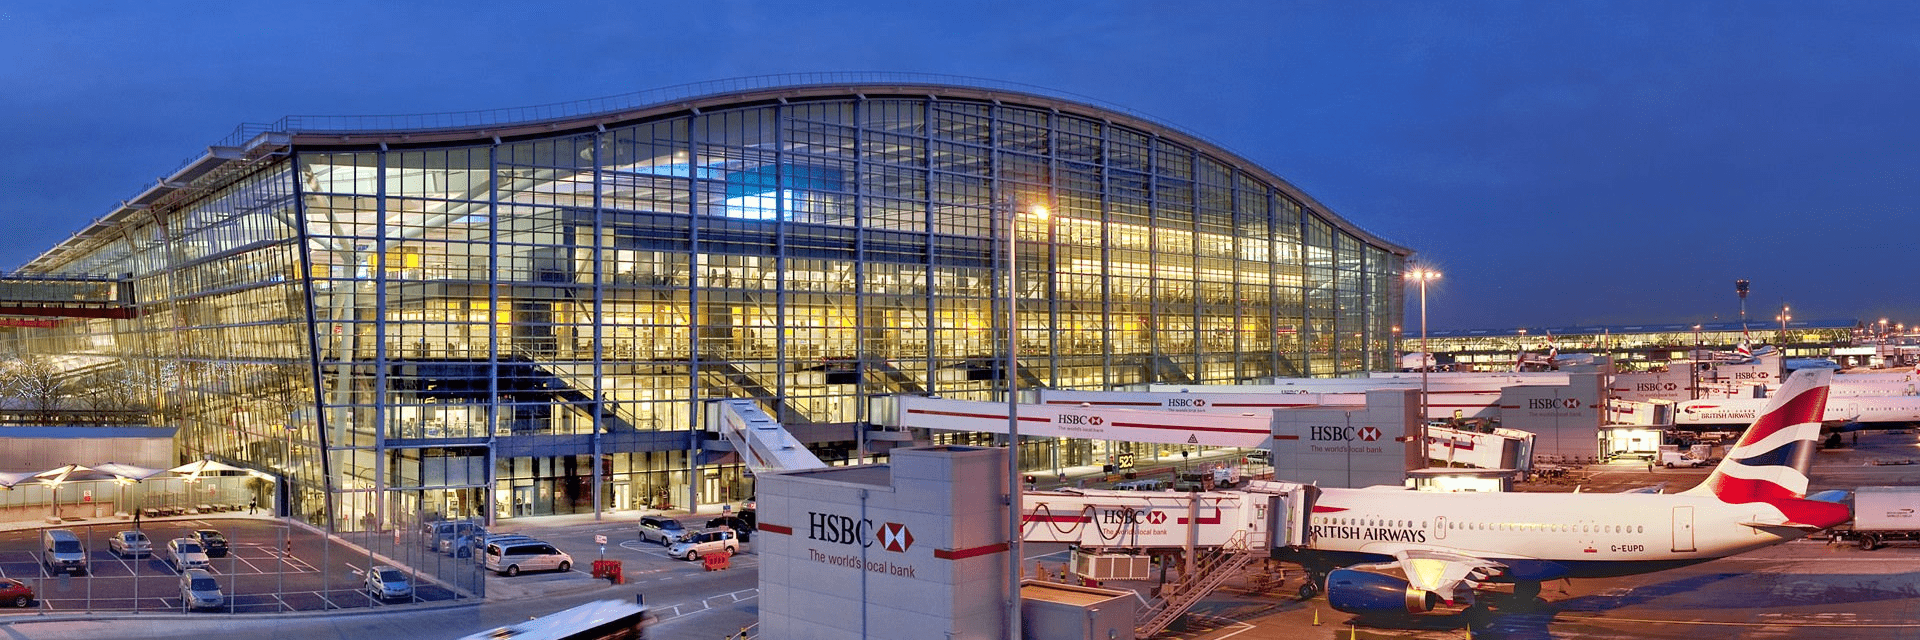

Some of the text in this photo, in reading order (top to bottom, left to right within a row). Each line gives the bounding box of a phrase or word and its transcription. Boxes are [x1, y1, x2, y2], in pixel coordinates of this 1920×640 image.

[1735, 371, 1758, 380] HSBC
[1636, 382, 1663, 391] HSBC
[1168, 398, 1193, 407] HSBC
[1528, 398, 1562, 409] HSBC
[1058, 414, 1088, 425] HSBC
[1310, 426, 1355, 441] HSBC
[1311, 444, 1323, 452] The
[1119, 455, 1134, 469] 523
[1103, 509, 1145, 524] HSBC
[808, 511, 873, 548] HSBC
[1363, 527, 1426, 543] AIRWAYS
[1611, 544, 1645, 553] G-EUPD
[808, 548, 826, 564] The
[828, 553, 862, 570] world's
[890, 562, 916, 579] bank
